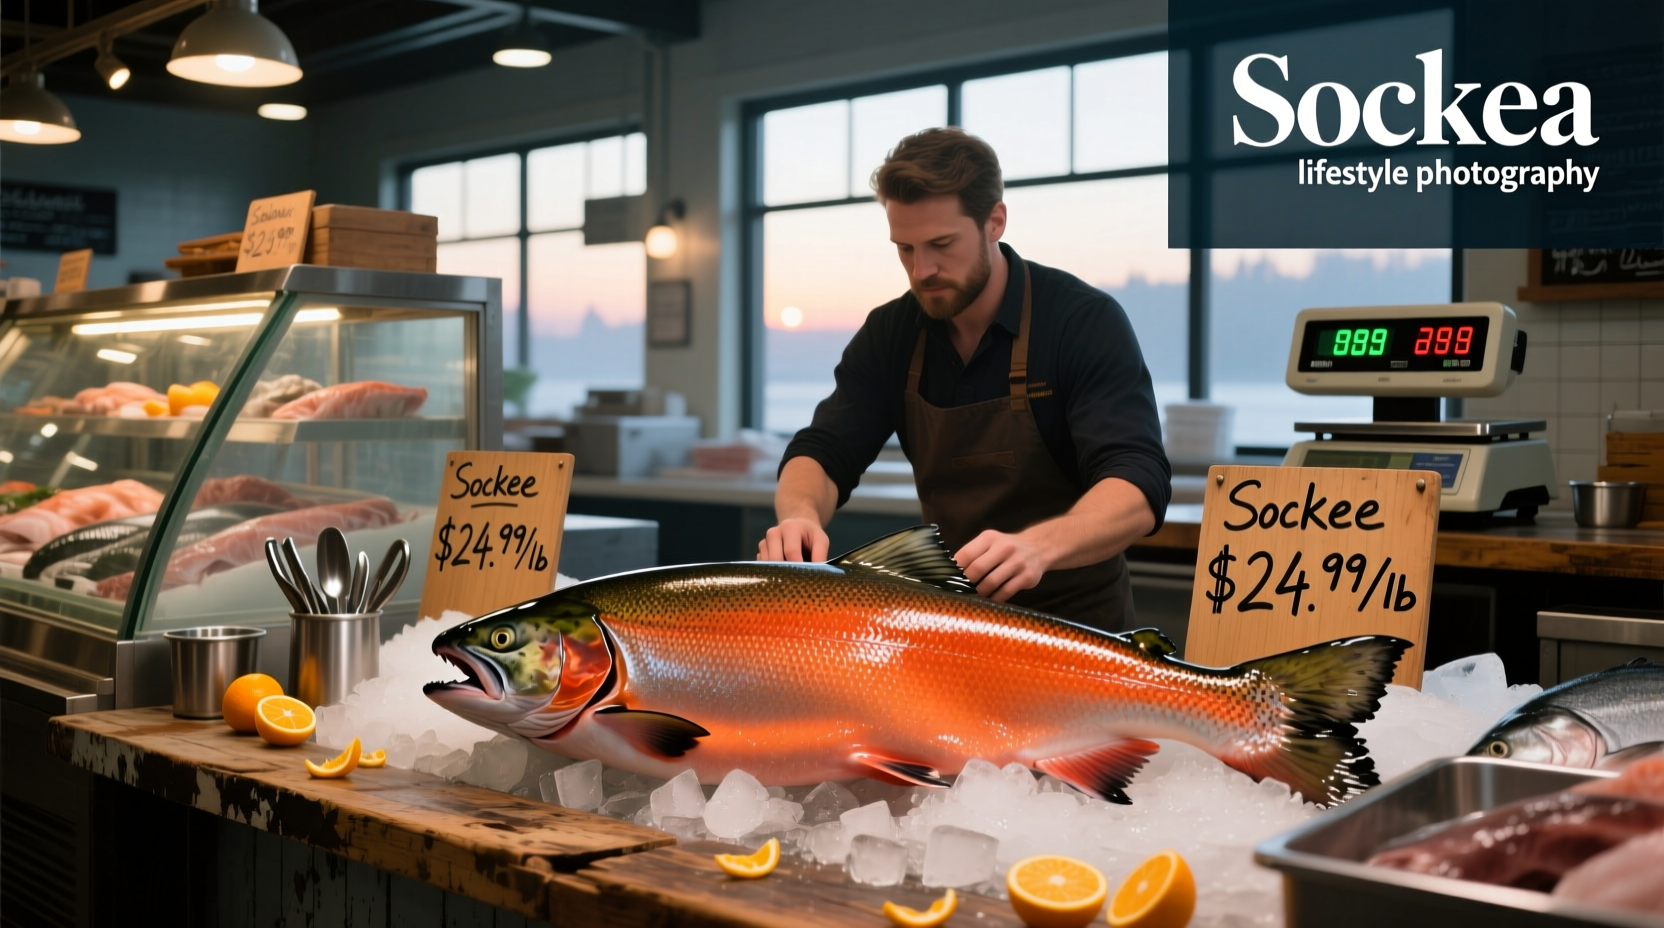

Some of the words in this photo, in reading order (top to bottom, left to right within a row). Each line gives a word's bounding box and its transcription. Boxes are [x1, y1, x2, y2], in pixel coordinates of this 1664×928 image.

[450, 461, 539, 500] Sockee
[1223, 479, 1385, 531] Sockee
[434, 515, 549, 573] $24.99/lb
[1205, 543, 1418, 618] $24.99/lb
